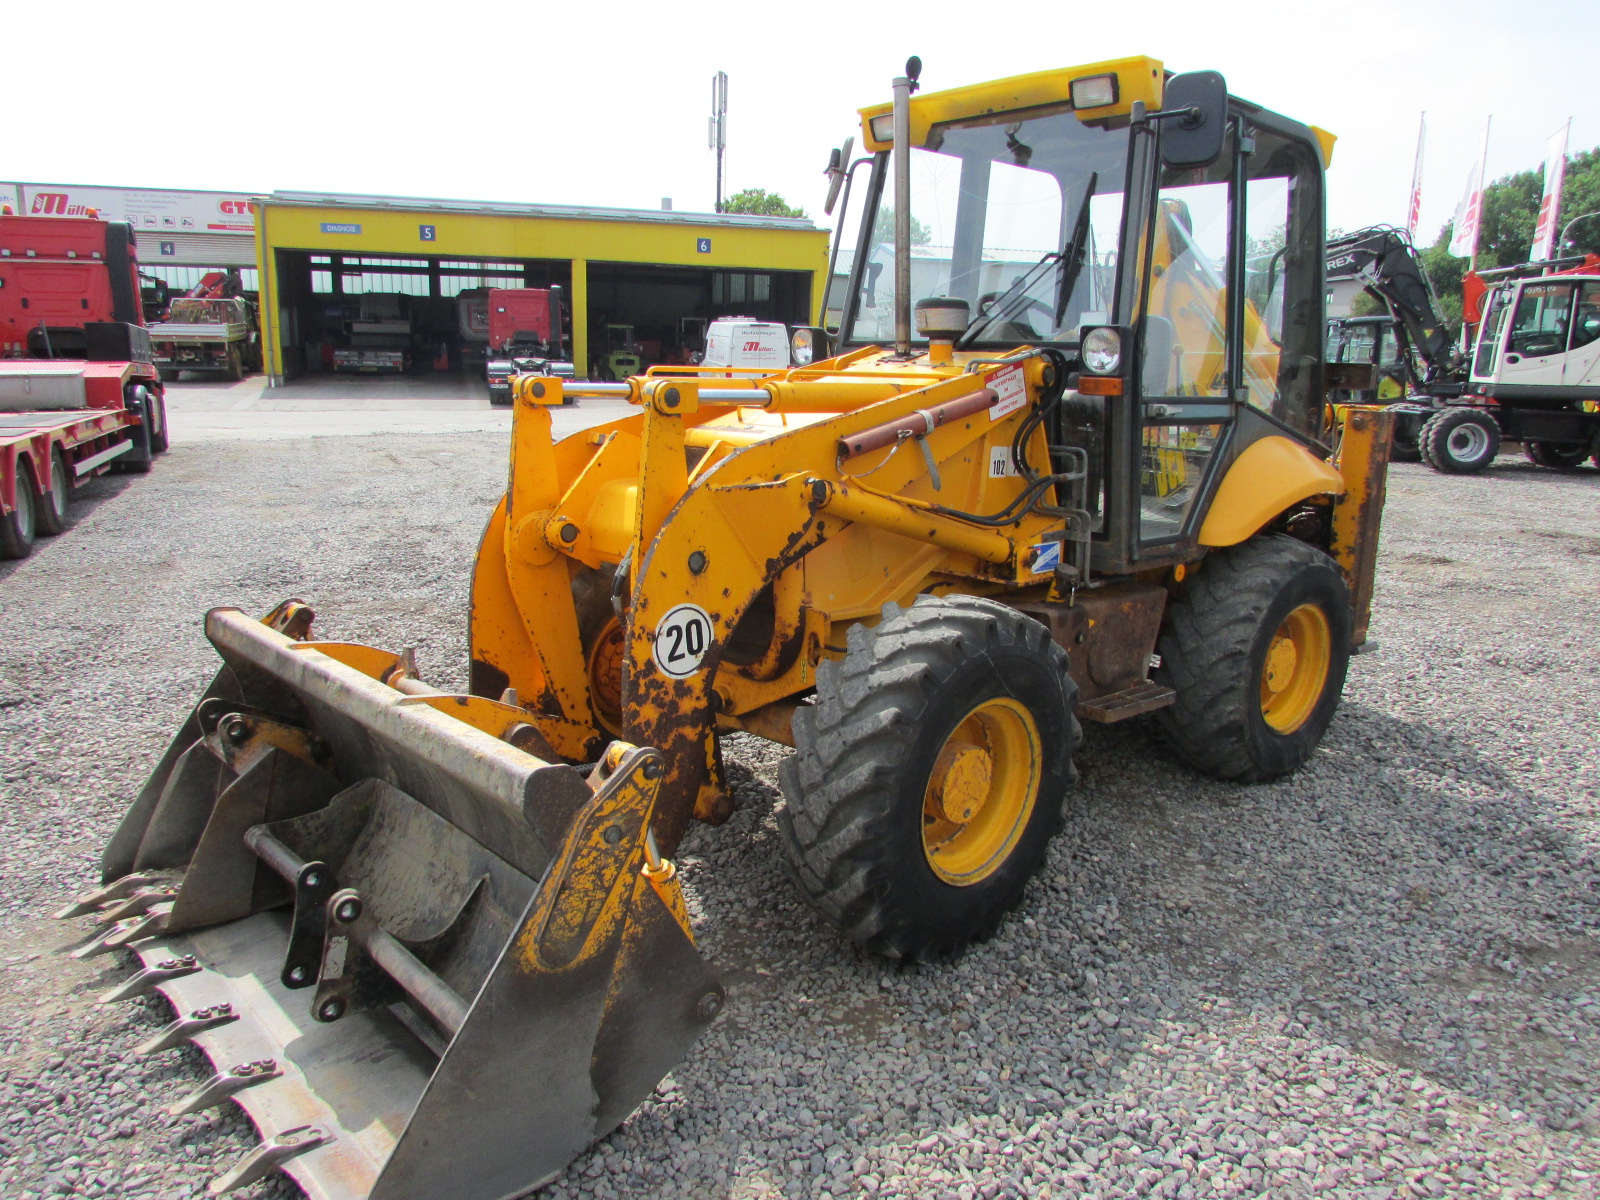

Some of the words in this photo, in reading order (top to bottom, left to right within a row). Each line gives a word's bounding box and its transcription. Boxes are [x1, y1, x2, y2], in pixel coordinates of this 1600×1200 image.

[326, 225, 356, 233] DIAGNOSE
[424, 227, 432, 239] 5
[164, 244, 171, 254] 4
[700, 240, 708, 252] 6
[993, 460, 1006, 475] 102
[666, 618, 704, 663] 20
